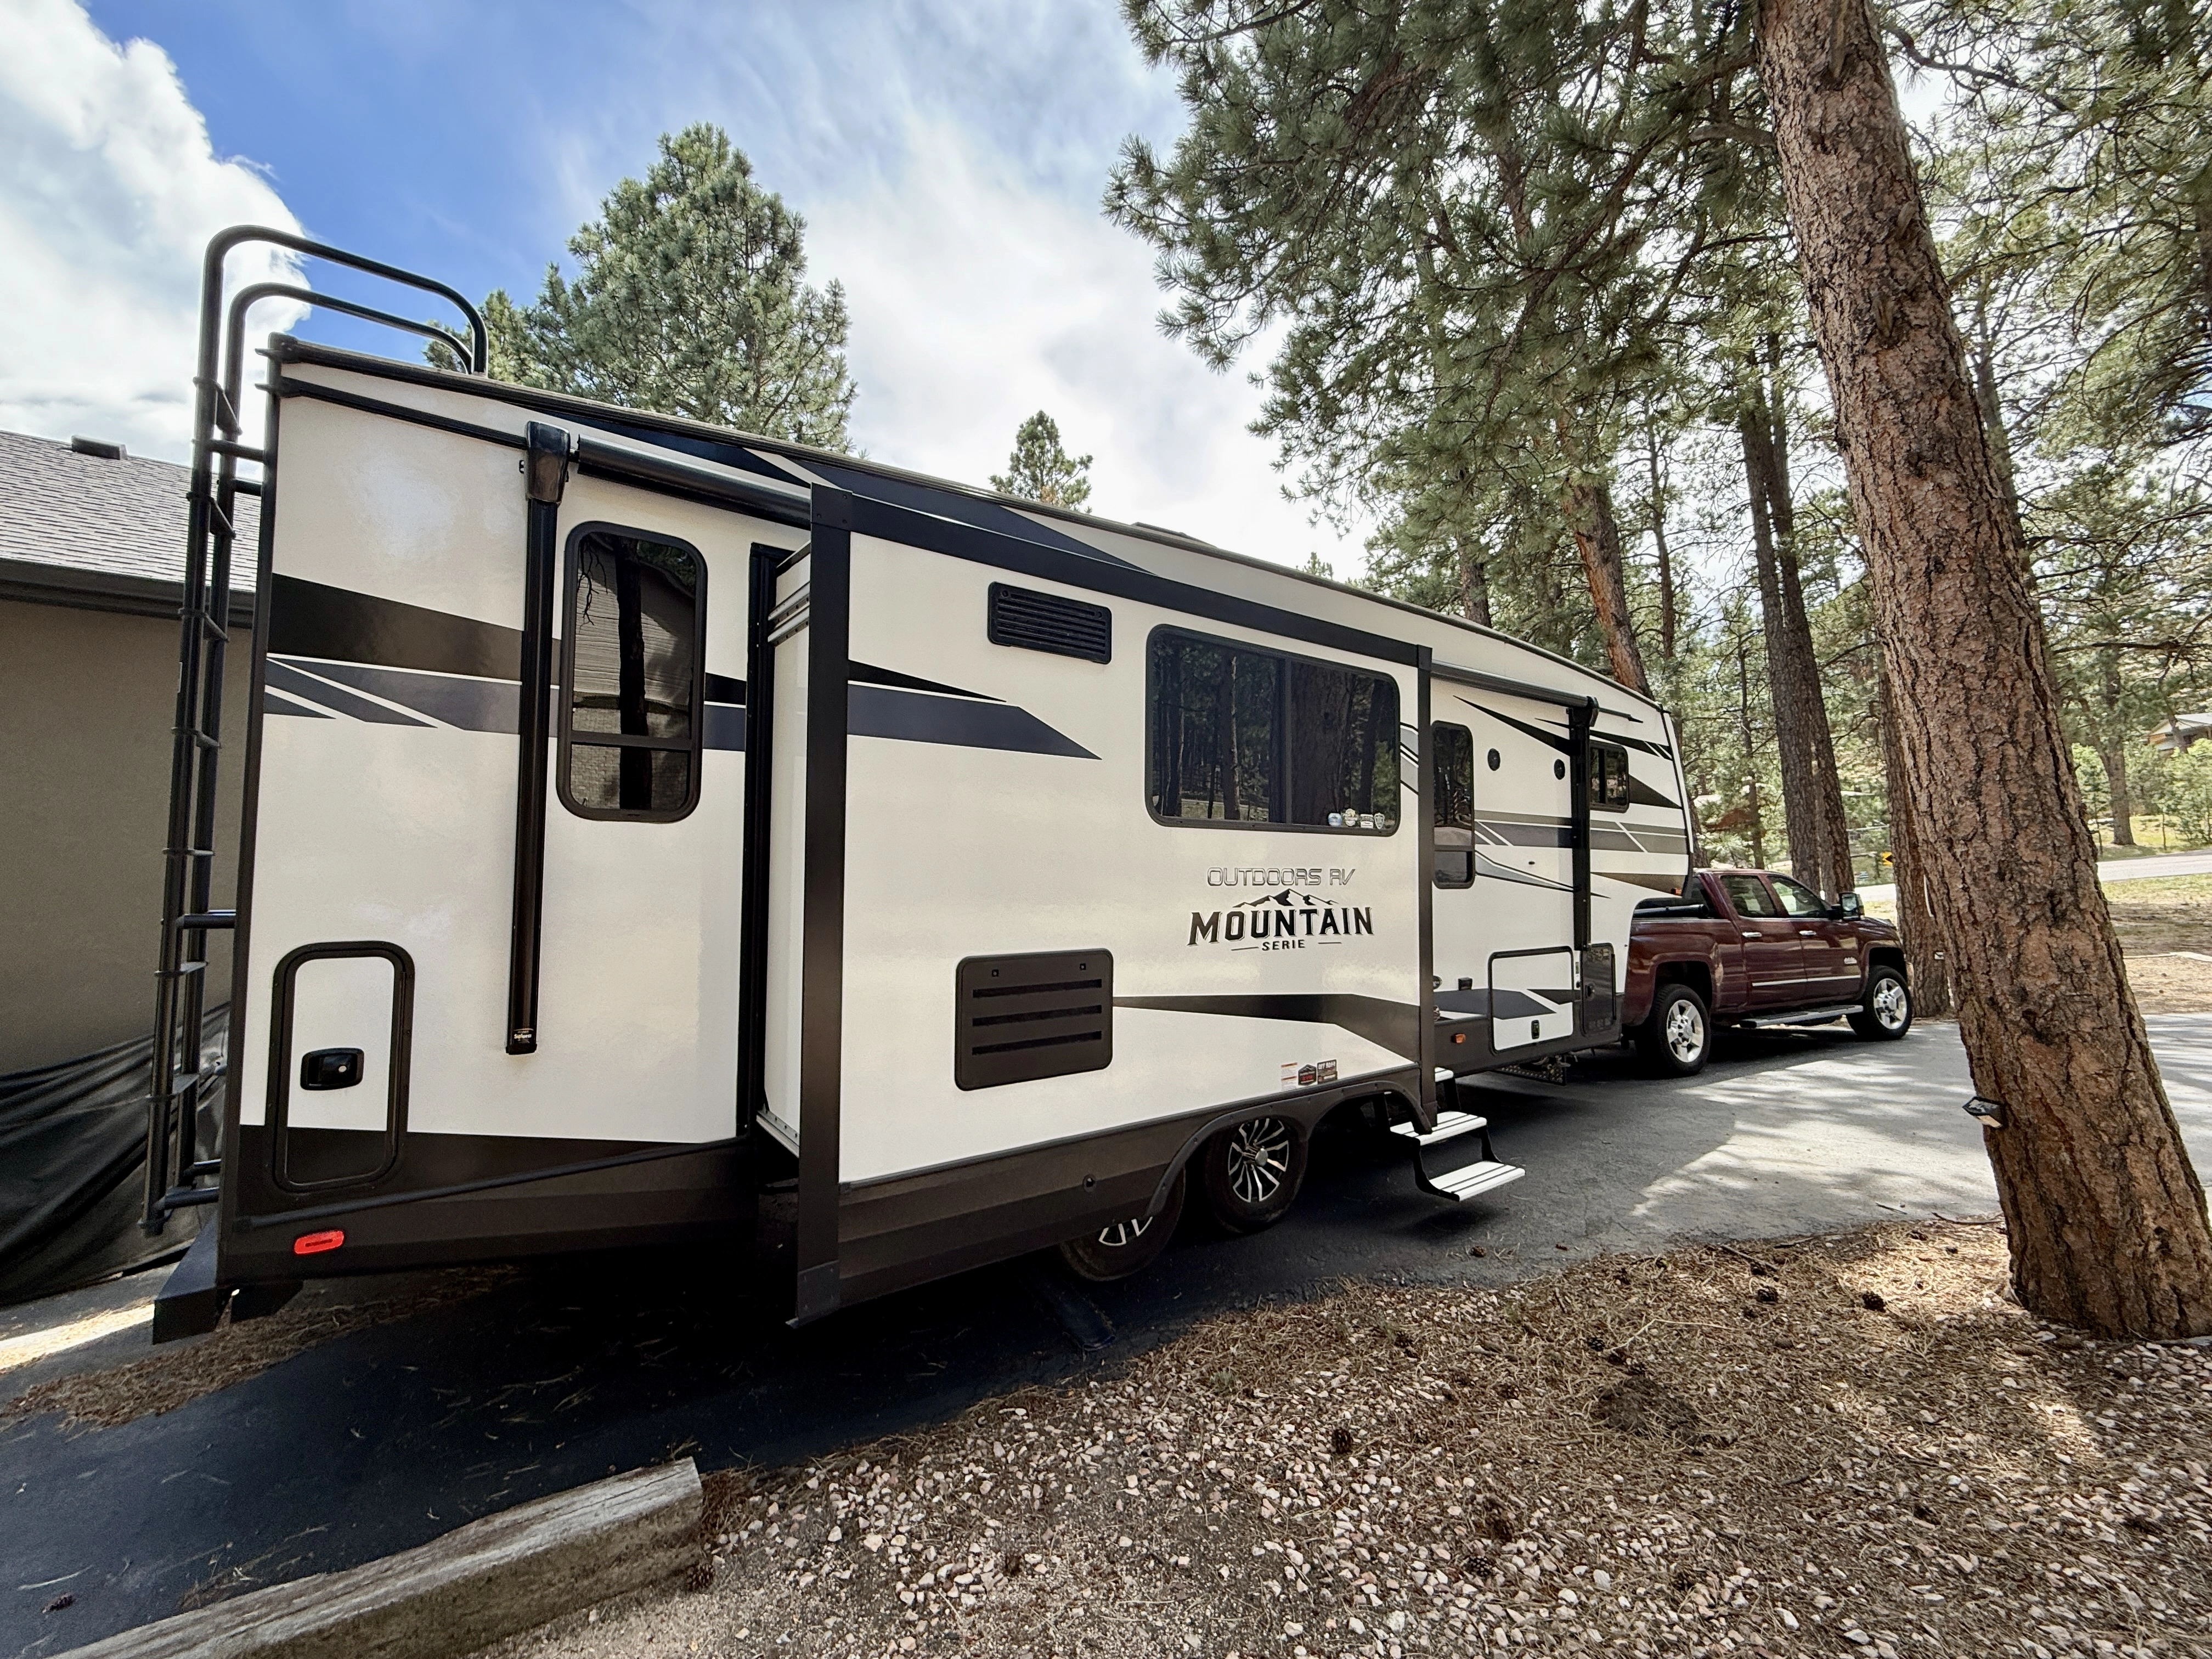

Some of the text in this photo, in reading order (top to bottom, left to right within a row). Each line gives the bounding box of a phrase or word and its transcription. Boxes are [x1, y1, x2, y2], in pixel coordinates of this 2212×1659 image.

[1207, 867, 1355, 886] OUTDOORS RV
[1187, 907, 1374, 946] MOUNTAIN
[1262, 939, 1306, 951] SERIE
